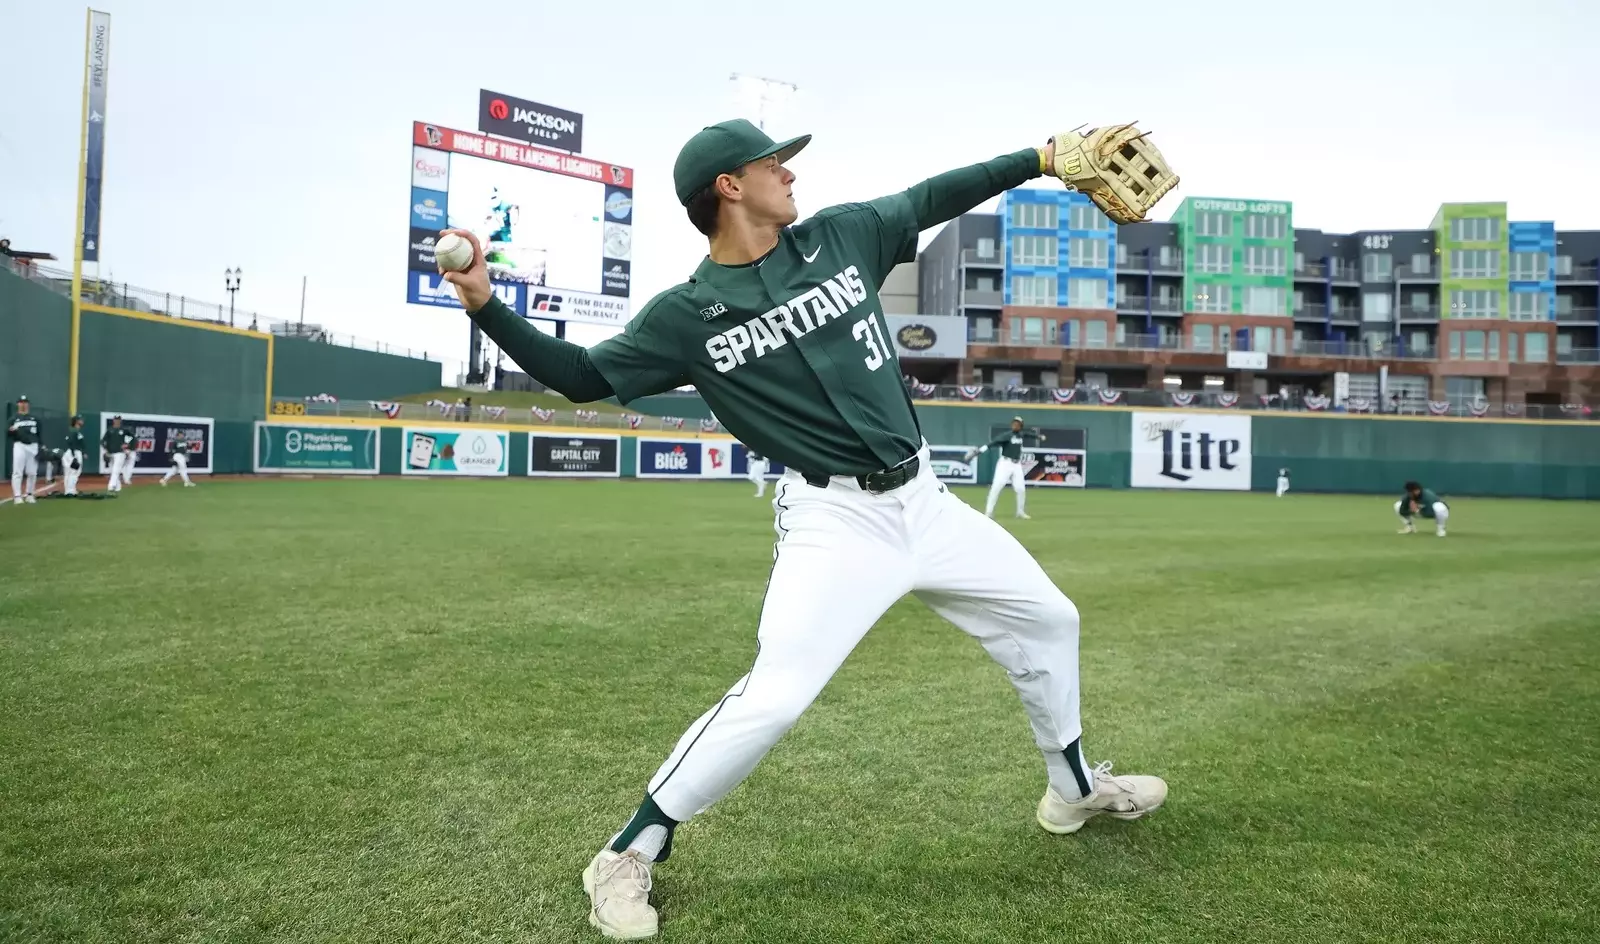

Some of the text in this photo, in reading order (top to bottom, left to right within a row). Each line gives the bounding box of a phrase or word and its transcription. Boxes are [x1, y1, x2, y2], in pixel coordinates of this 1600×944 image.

[513, 106, 575, 134] JACKSON
[527, 126, 559, 140] FIELD
[453, 133, 484, 154] HOME
[484, 140, 499, 157] OF
[500, 143, 519, 161] THE
[1194, 199, 1247, 211] OUTFIELD
[567, 296, 591, 307] FARM
[705, 265, 867, 374] SPARTANS
[852, 311, 892, 372] 31
[303, 432, 348, 444] Physicians
[303, 443, 353, 452] Health Plan
[550, 449, 601, 461] CAPITAL CITY
[1158, 429, 1241, 482] Lite
[654, 451, 688, 470] Blue
